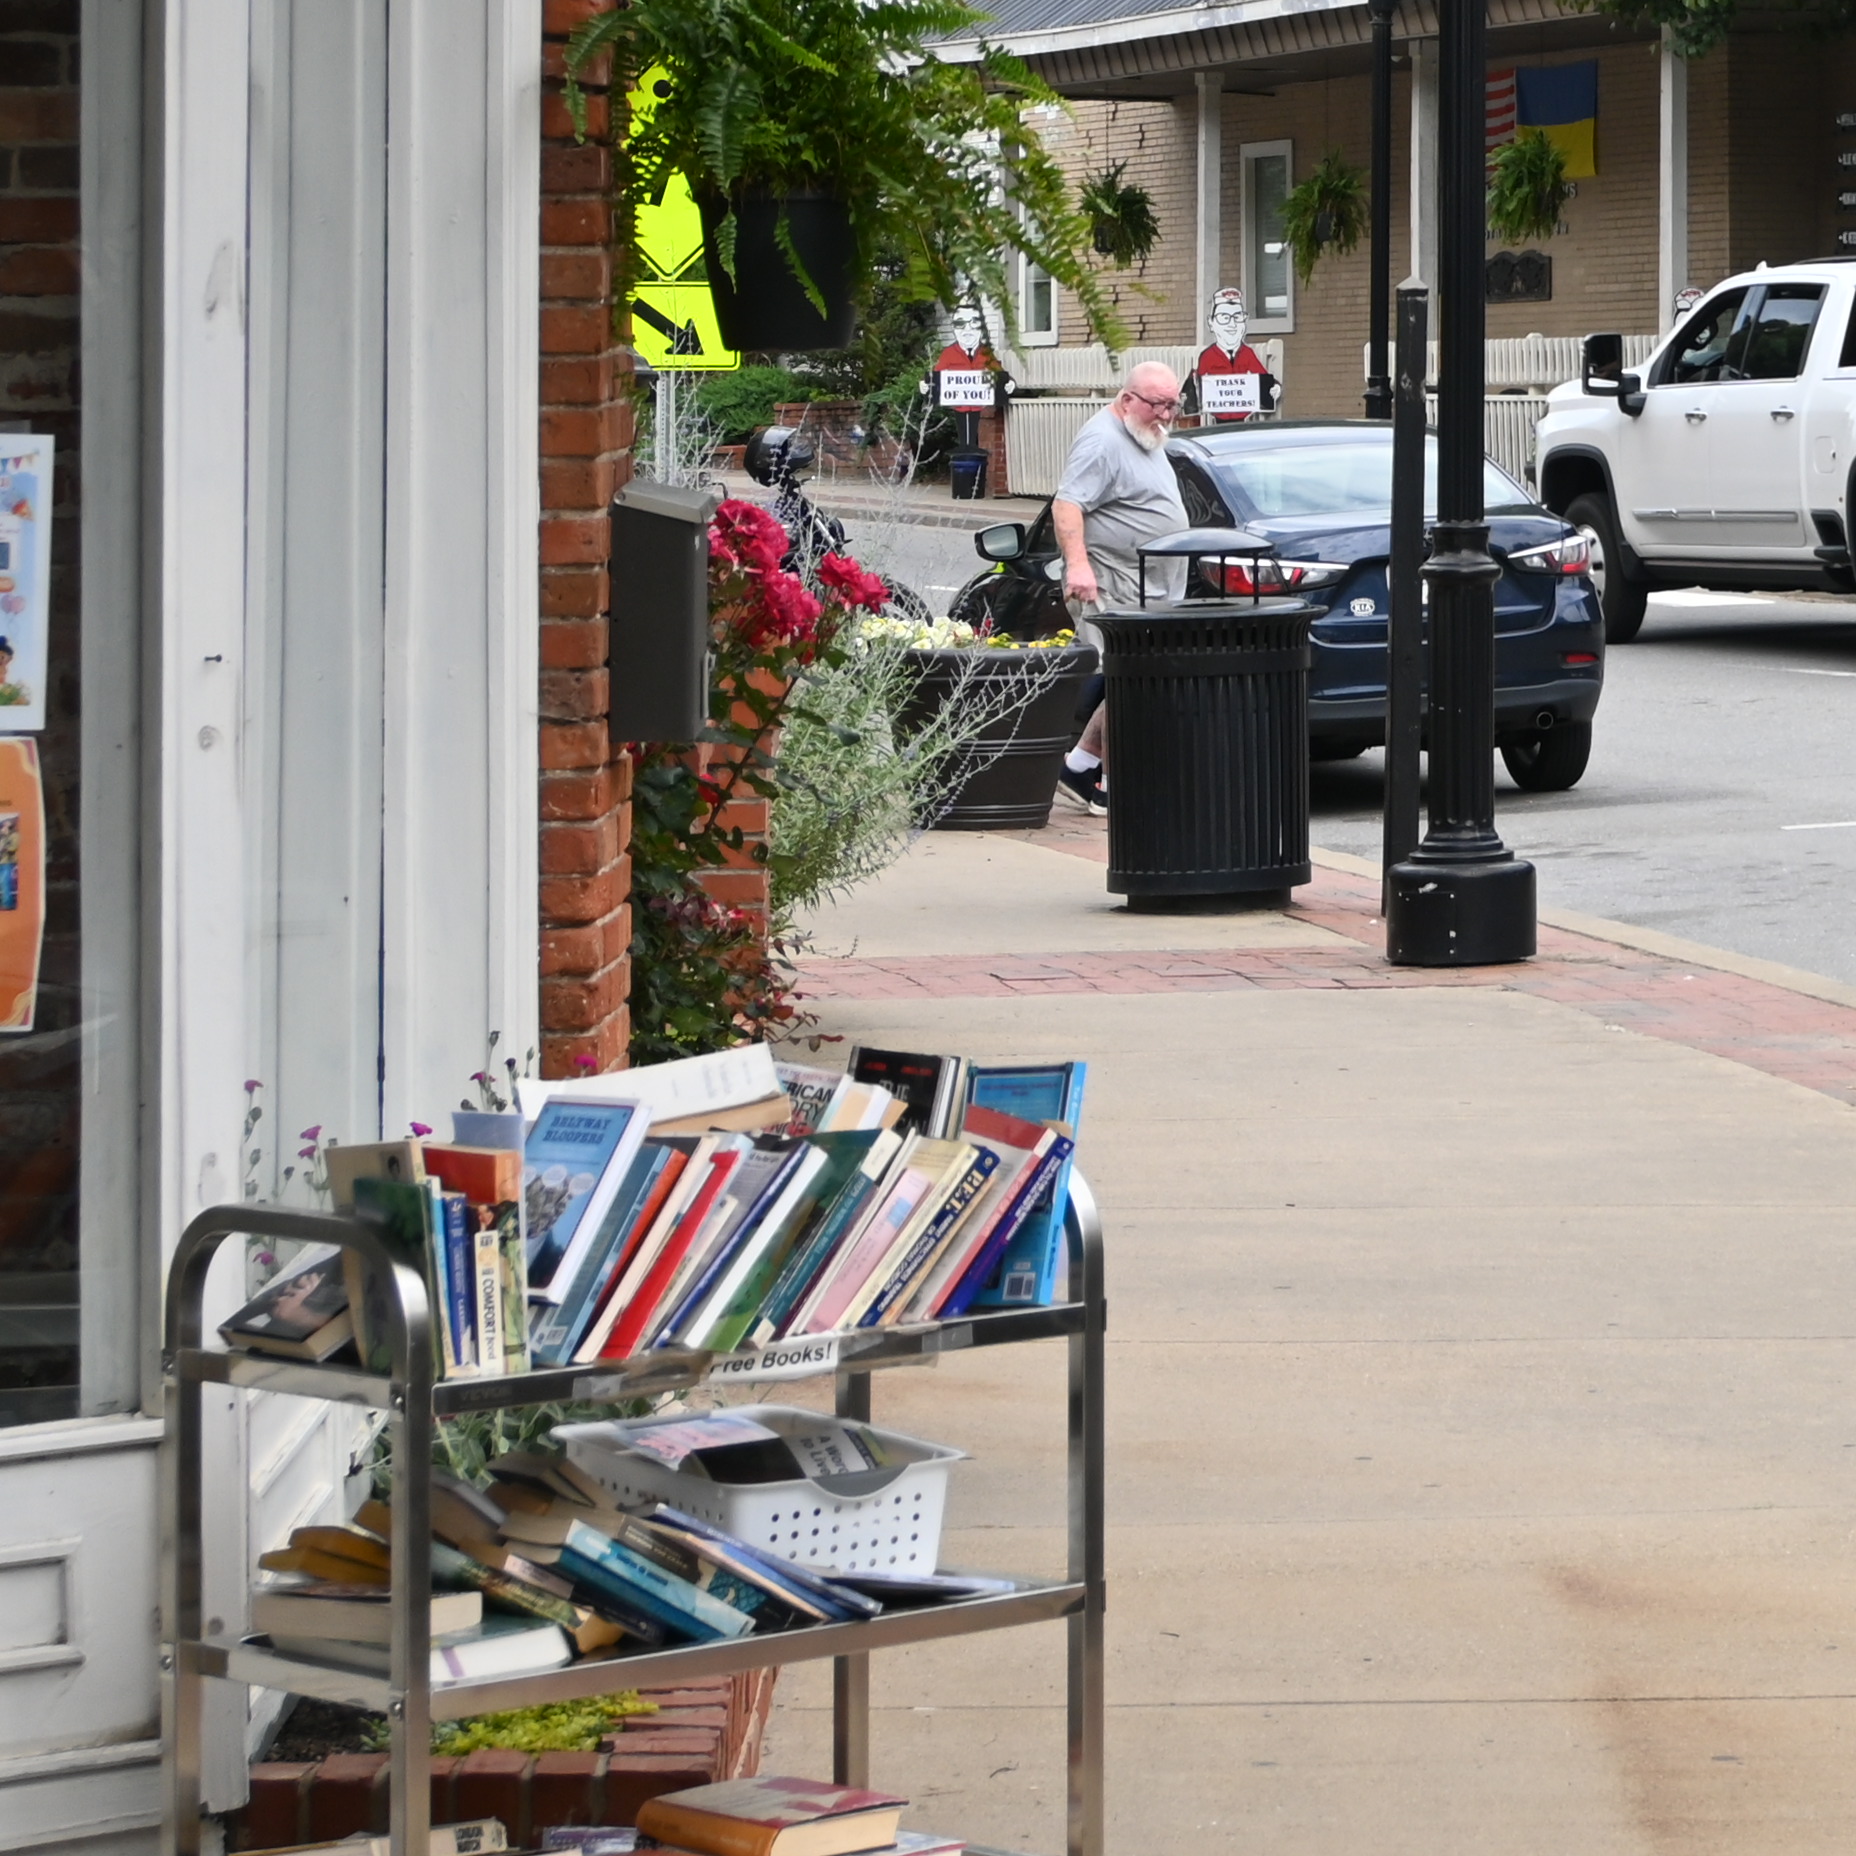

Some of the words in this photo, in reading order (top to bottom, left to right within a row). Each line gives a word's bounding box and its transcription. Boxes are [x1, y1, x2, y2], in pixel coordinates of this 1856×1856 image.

[946, 375, 992, 385] PROUD
[944, 390, 959, 400] OF
[963, 390, 991, 400] YOU!
[1206, 400, 1256, 409] TEACHERS!
[551, 1116, 612, 1130] BELTWAY
[542, 1130, 605, 1144] BLOOPERS
[482, 1278, 496, 1333] COMFORT
[761, 1341, 832, 1369] Books!
